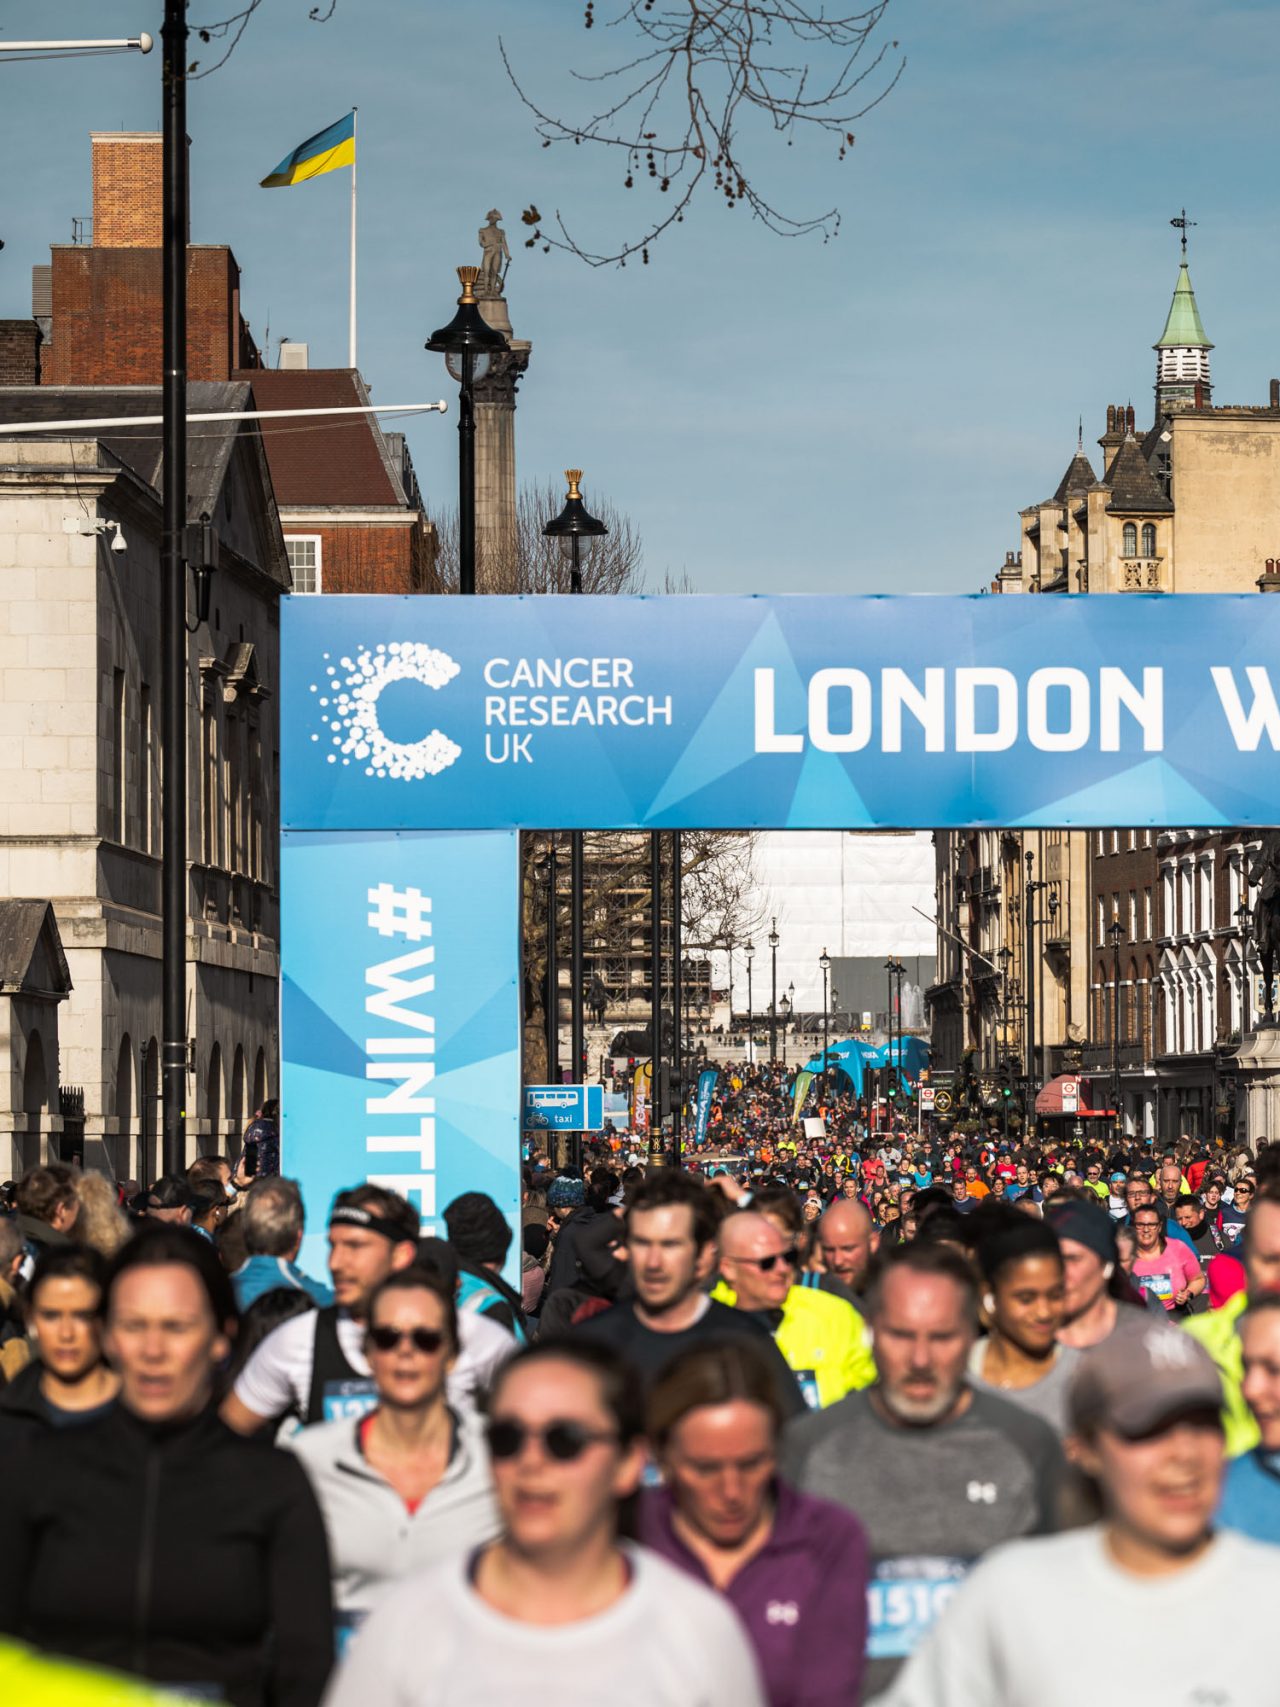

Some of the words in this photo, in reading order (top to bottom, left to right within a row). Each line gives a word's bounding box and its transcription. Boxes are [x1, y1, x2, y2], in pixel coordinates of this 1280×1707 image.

[483, 657, 634, 689] CANCER
[484, 695, 673, 727] RESEARCH
[754, 666, 1164, 753] LONDON
[484, 733, 533, 764] UK
[365, 882, 437, 1237] #WINTE
[554, 1114, 573, 1123] taxi
